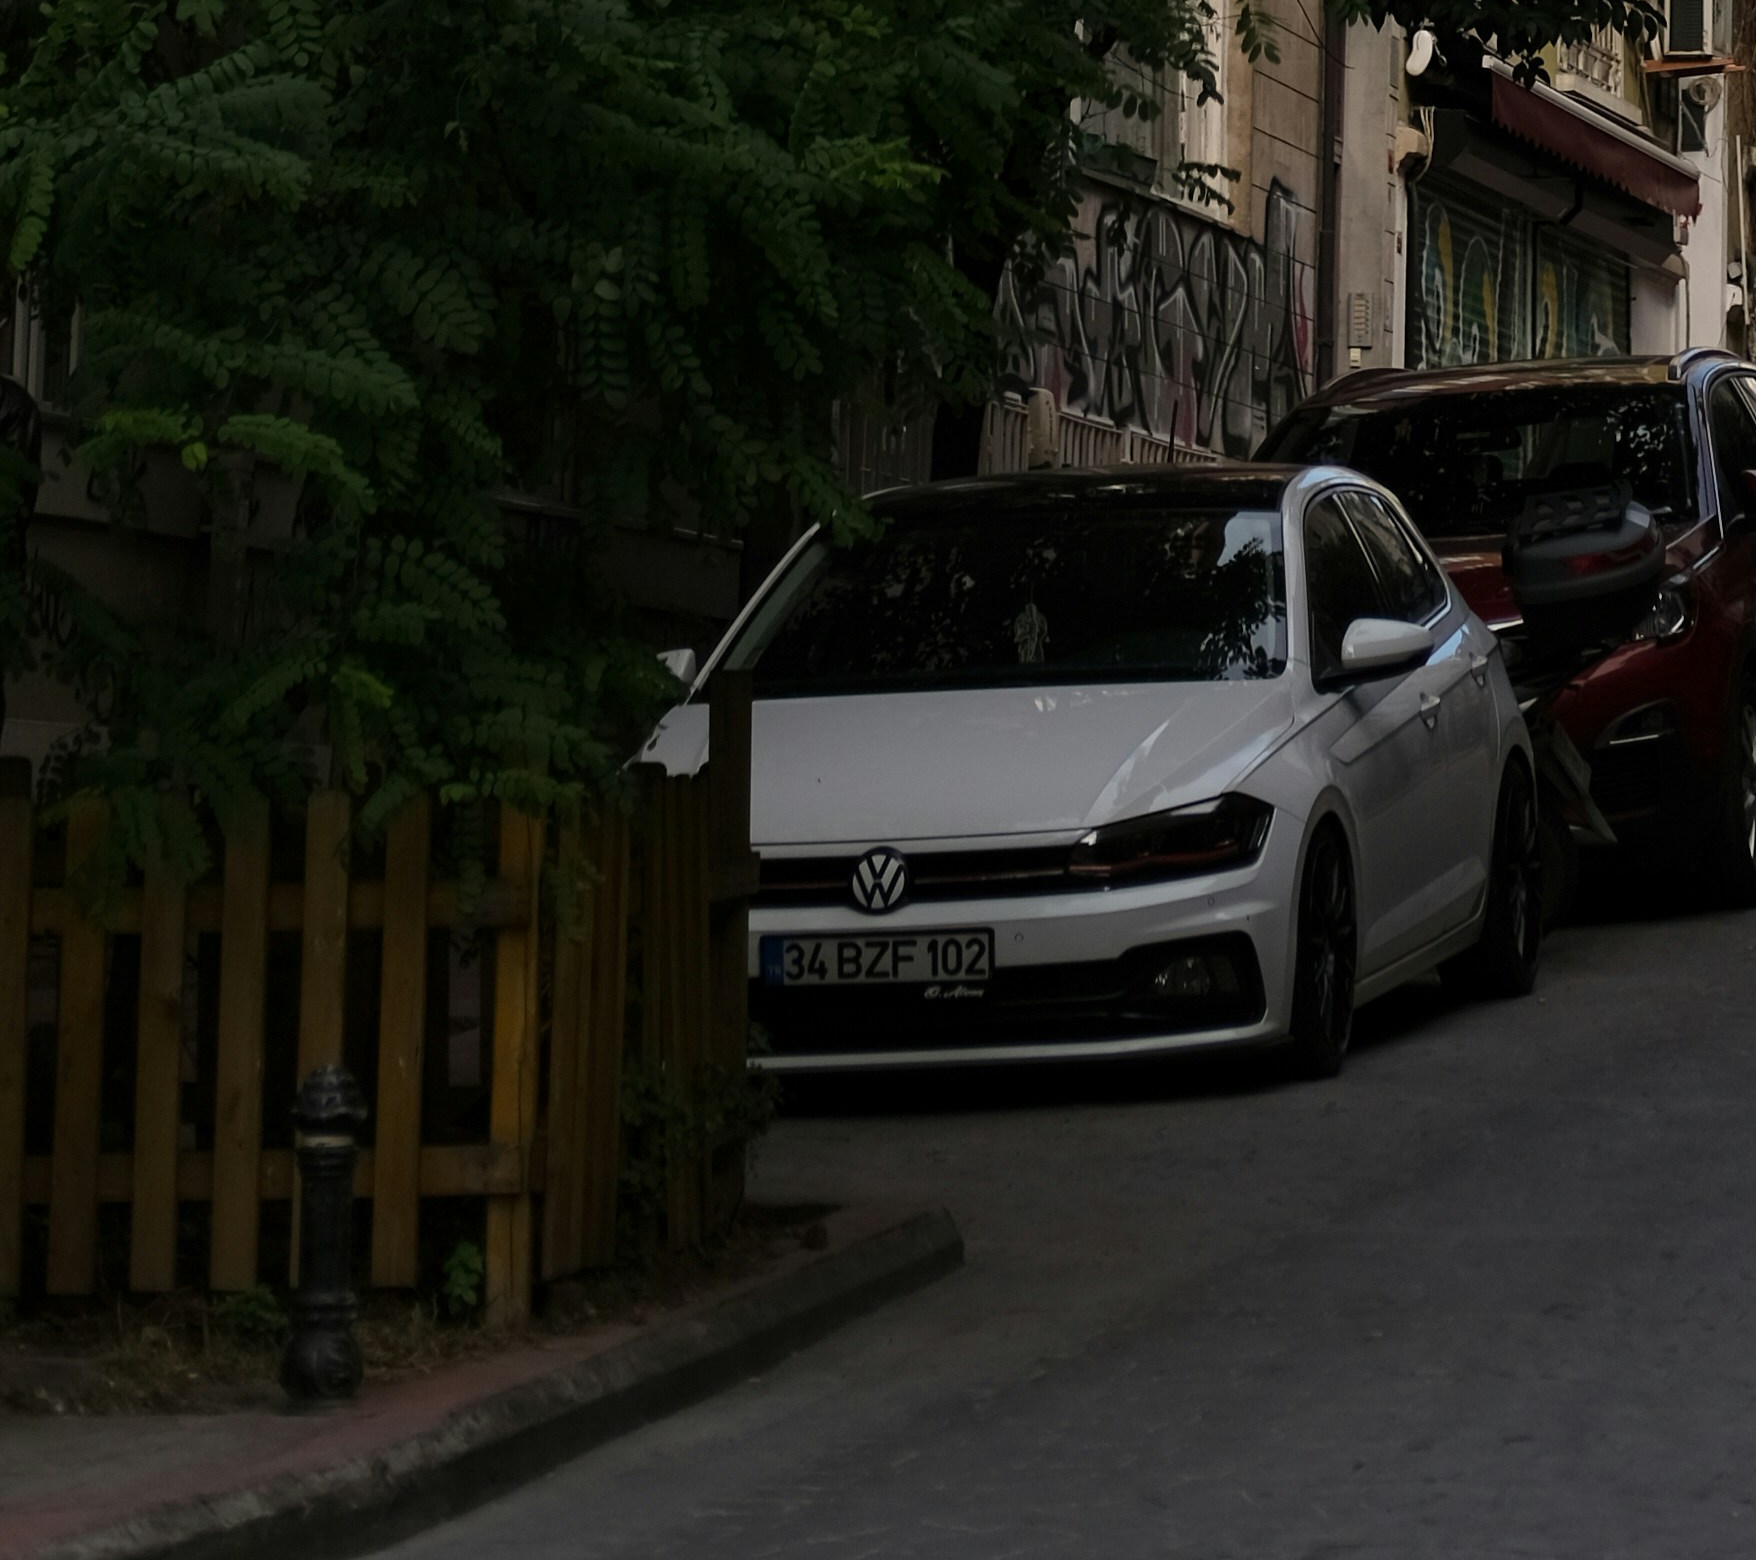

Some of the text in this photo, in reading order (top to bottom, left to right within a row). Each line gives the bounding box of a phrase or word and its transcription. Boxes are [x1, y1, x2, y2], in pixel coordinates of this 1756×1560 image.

[785, 941, 828, 980] 34
[836, 938, 917, 980] BZF
[927, 937, 987, 977] 102
